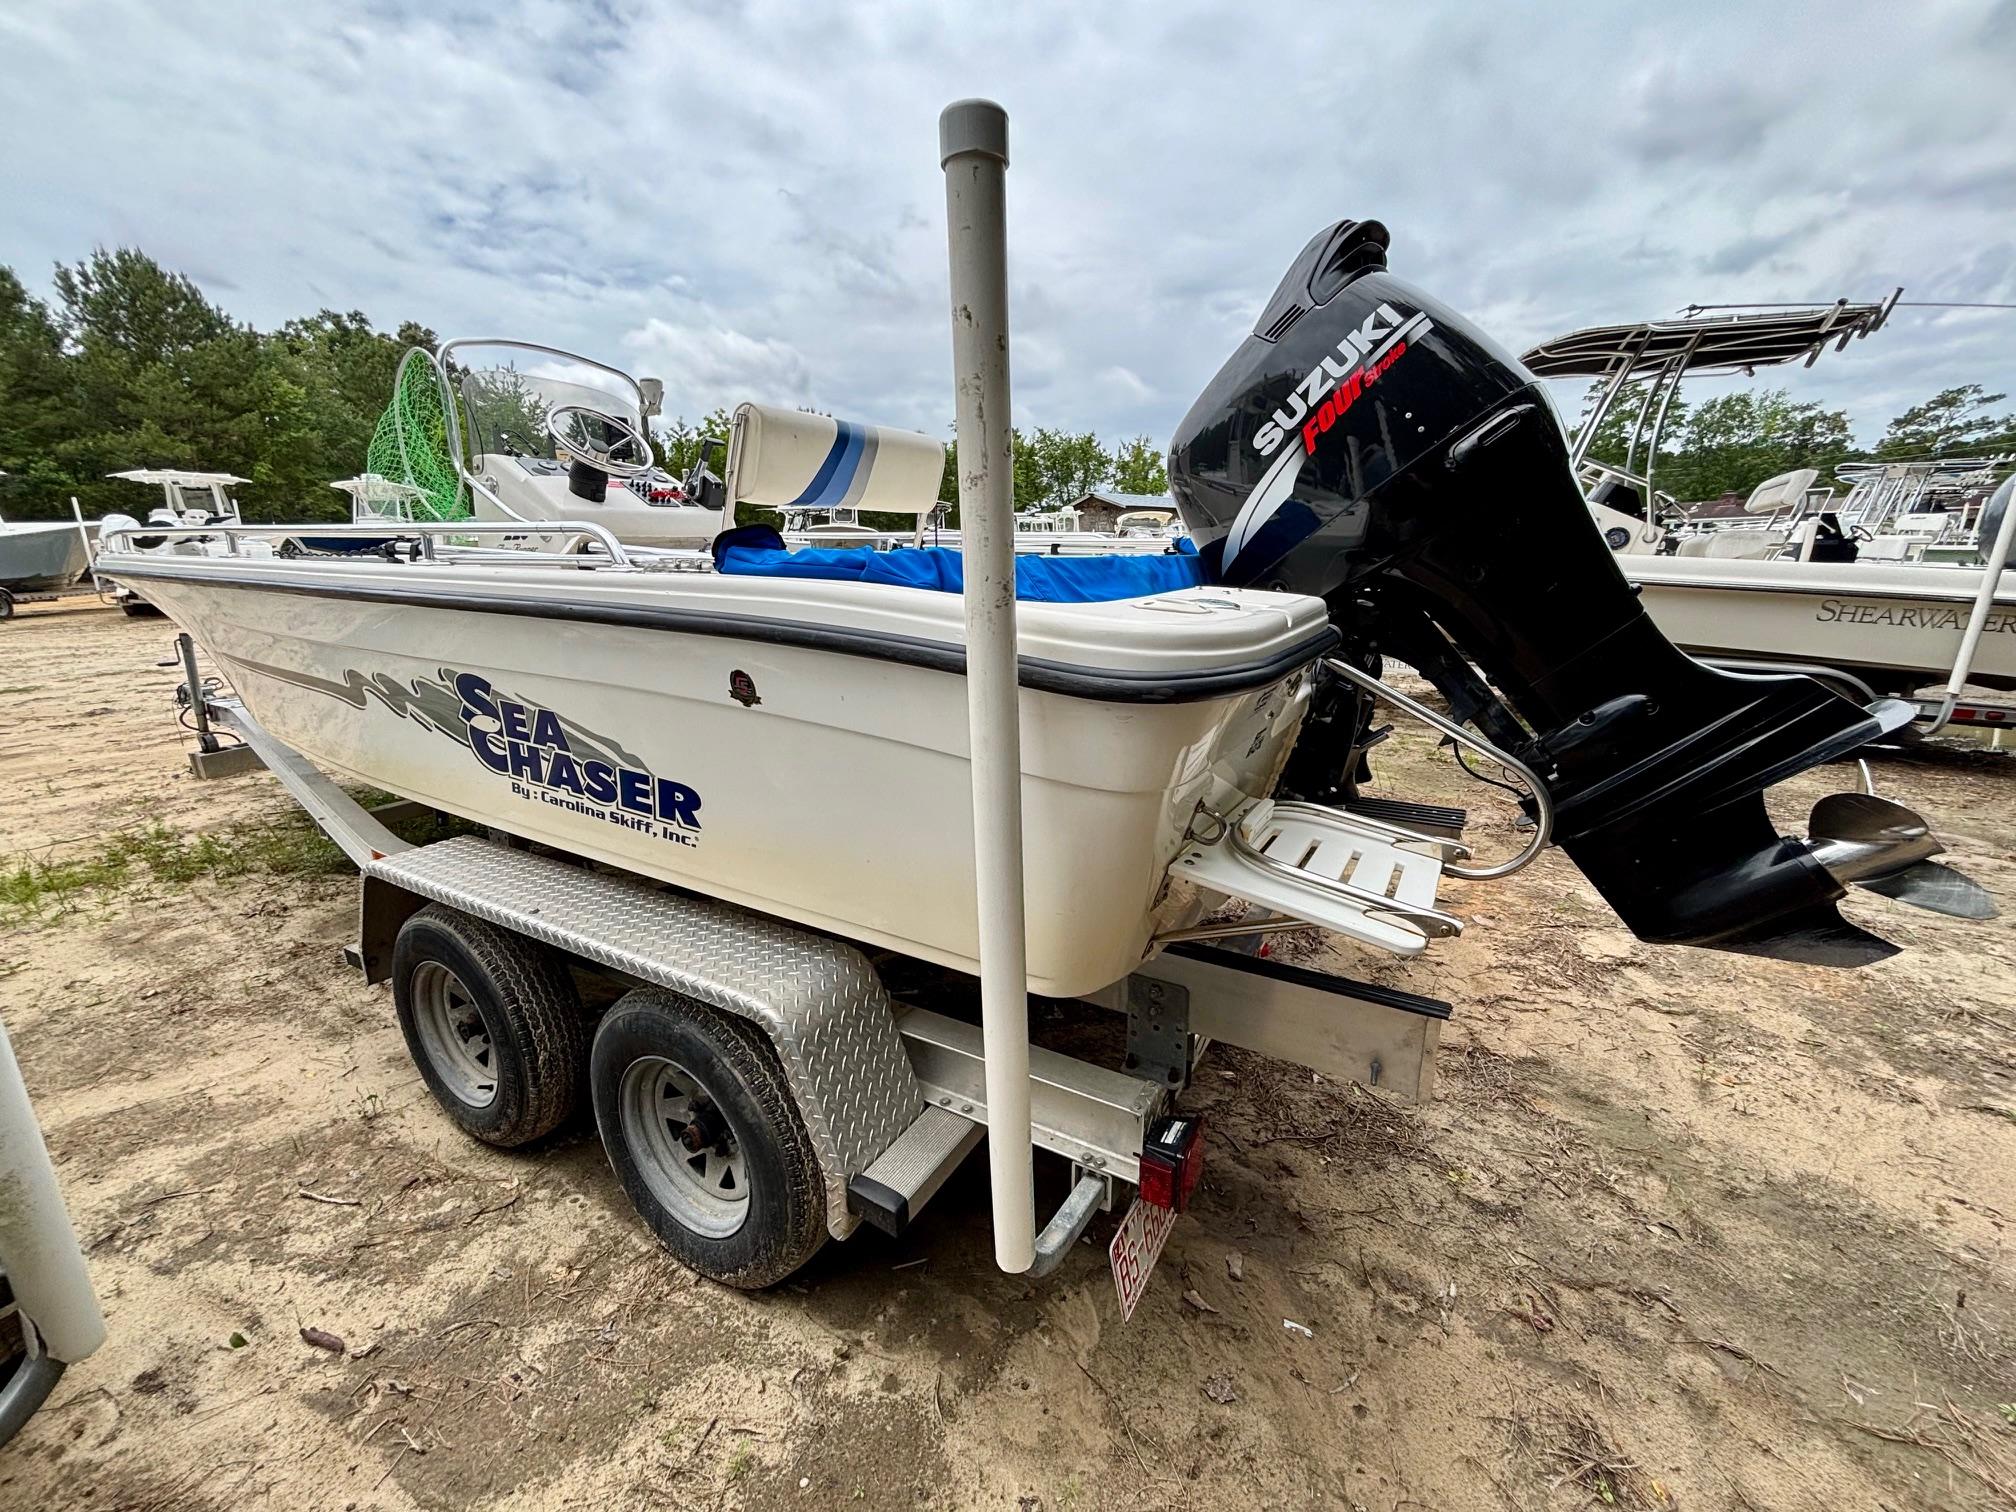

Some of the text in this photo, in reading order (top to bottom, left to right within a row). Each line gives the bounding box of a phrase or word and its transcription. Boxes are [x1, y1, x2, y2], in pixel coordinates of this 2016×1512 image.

[1252, 303, 1404, 457] SUZUKI
[454, 672, 573, 755] SEA
[468, 714, 703, 831] CHASER
[540, 790, 606, 820] Carolina
[609, 810, 658, 838] Skiff,
